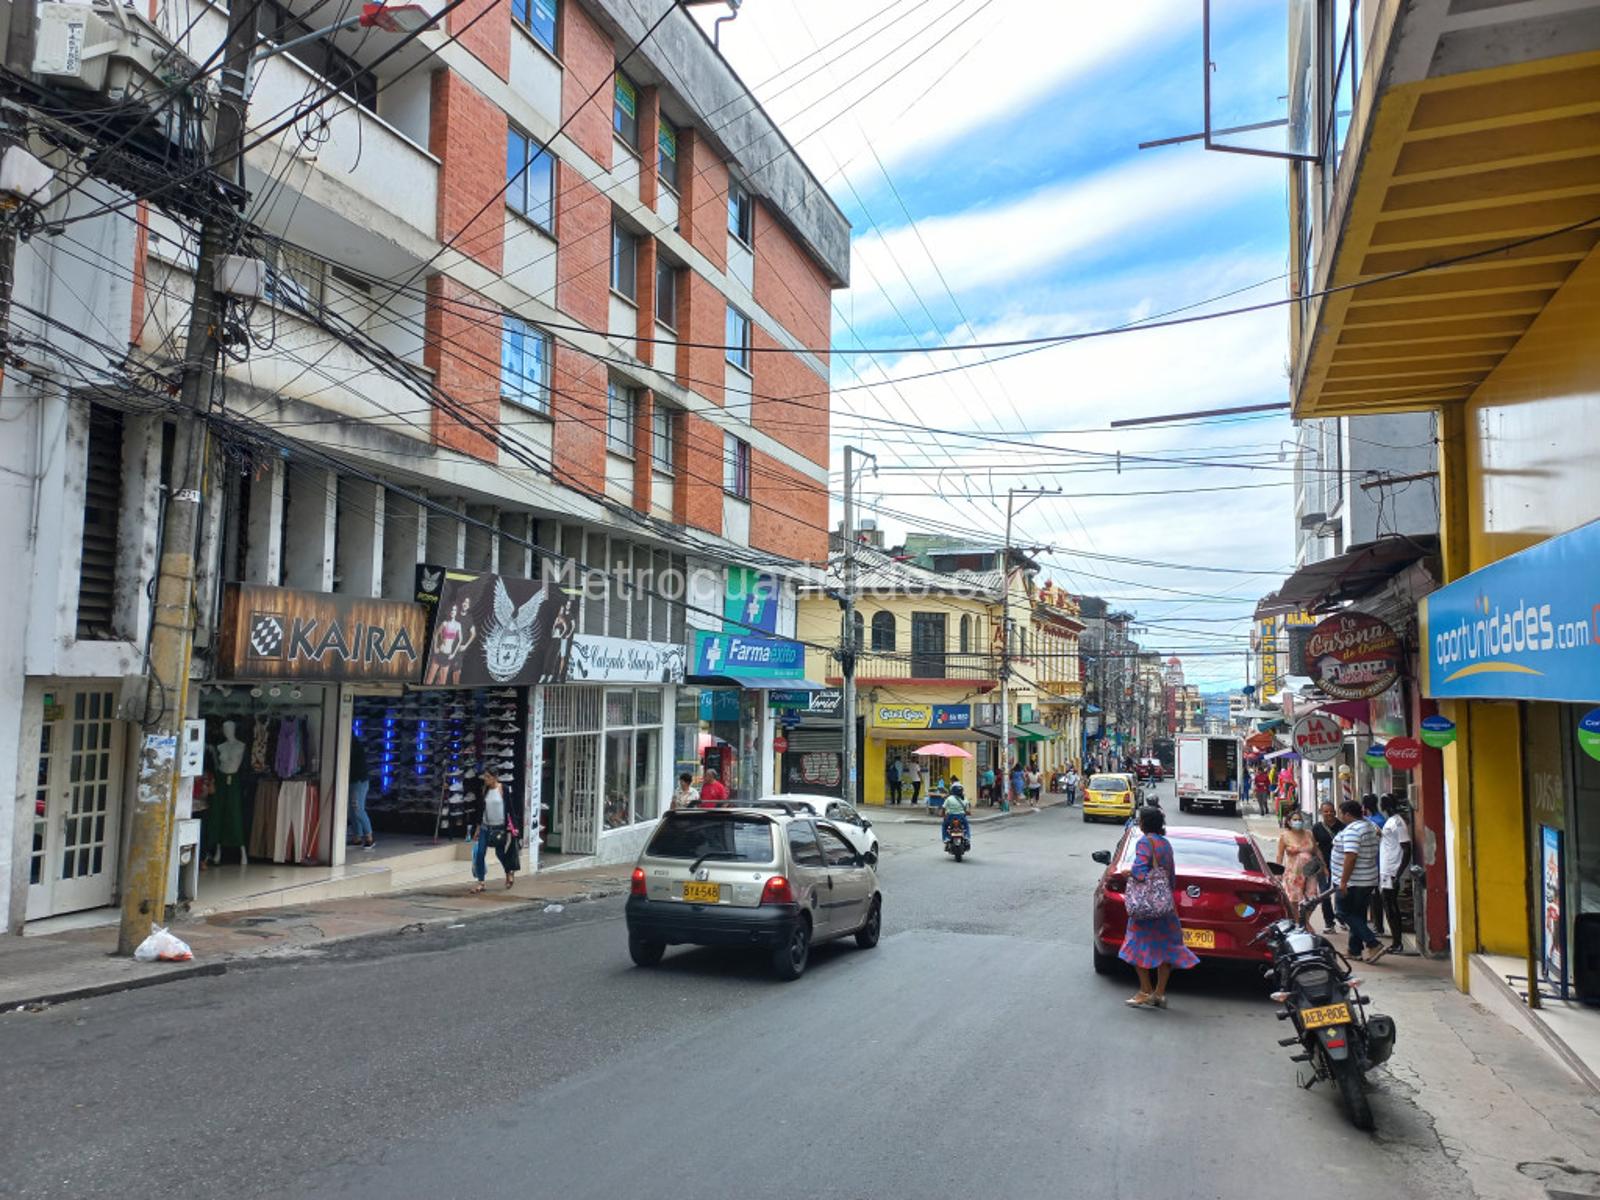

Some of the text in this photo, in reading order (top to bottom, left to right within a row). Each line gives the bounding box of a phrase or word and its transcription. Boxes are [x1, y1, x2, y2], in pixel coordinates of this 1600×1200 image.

[288, 617, 417, 664] KAIRA
[1307, 719, 1325, 732] LA
[1296, 731, 1341, 748] PELU
